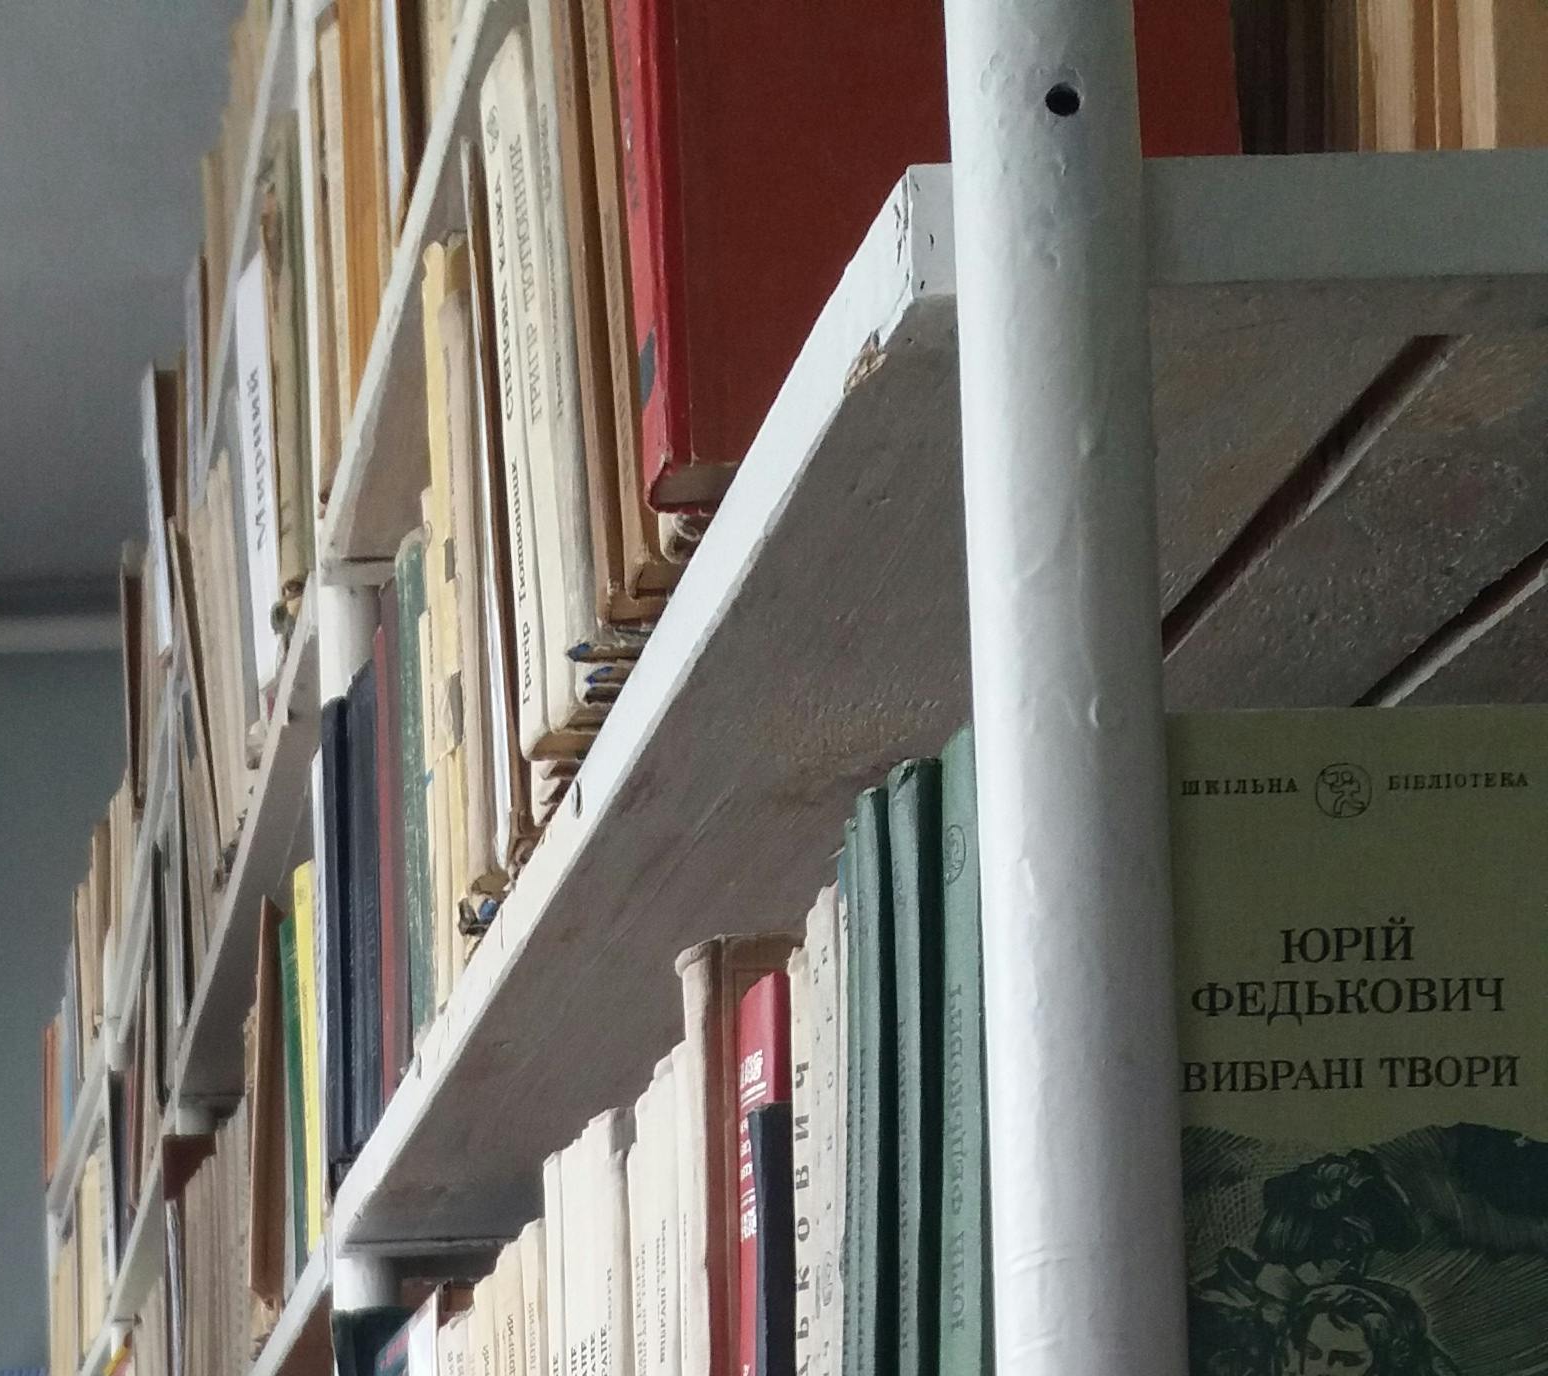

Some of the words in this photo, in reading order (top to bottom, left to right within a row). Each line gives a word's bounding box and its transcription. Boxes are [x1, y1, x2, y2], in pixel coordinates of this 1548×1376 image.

[494, 169, 506, 274] КАЗКА
[509, 132, 535, 314] ТЮТЮННИК
[501, 281, 514, 421] СТЕПОВА
[526, 321, 542, 425] ГРИГІР
[246, 366, 267, 553] Мирний
[1180, 777, 1300, 797] ШКІЛЬНА
[1388, 771, 1529, 792] БІБЛІОТЕКА
[1280, 915, 1416, 965] ЮРІЙ
[1191, 976, 1505, 1026] ФЕДЬКОВИЧ
[949, 981, 967, 1216] ФЕДЬКОВИЧ
[1179, 1058, 1364, 1094] ВИБРАНІ
[1380, 1055, 1521, 1089] ТВОРИ
